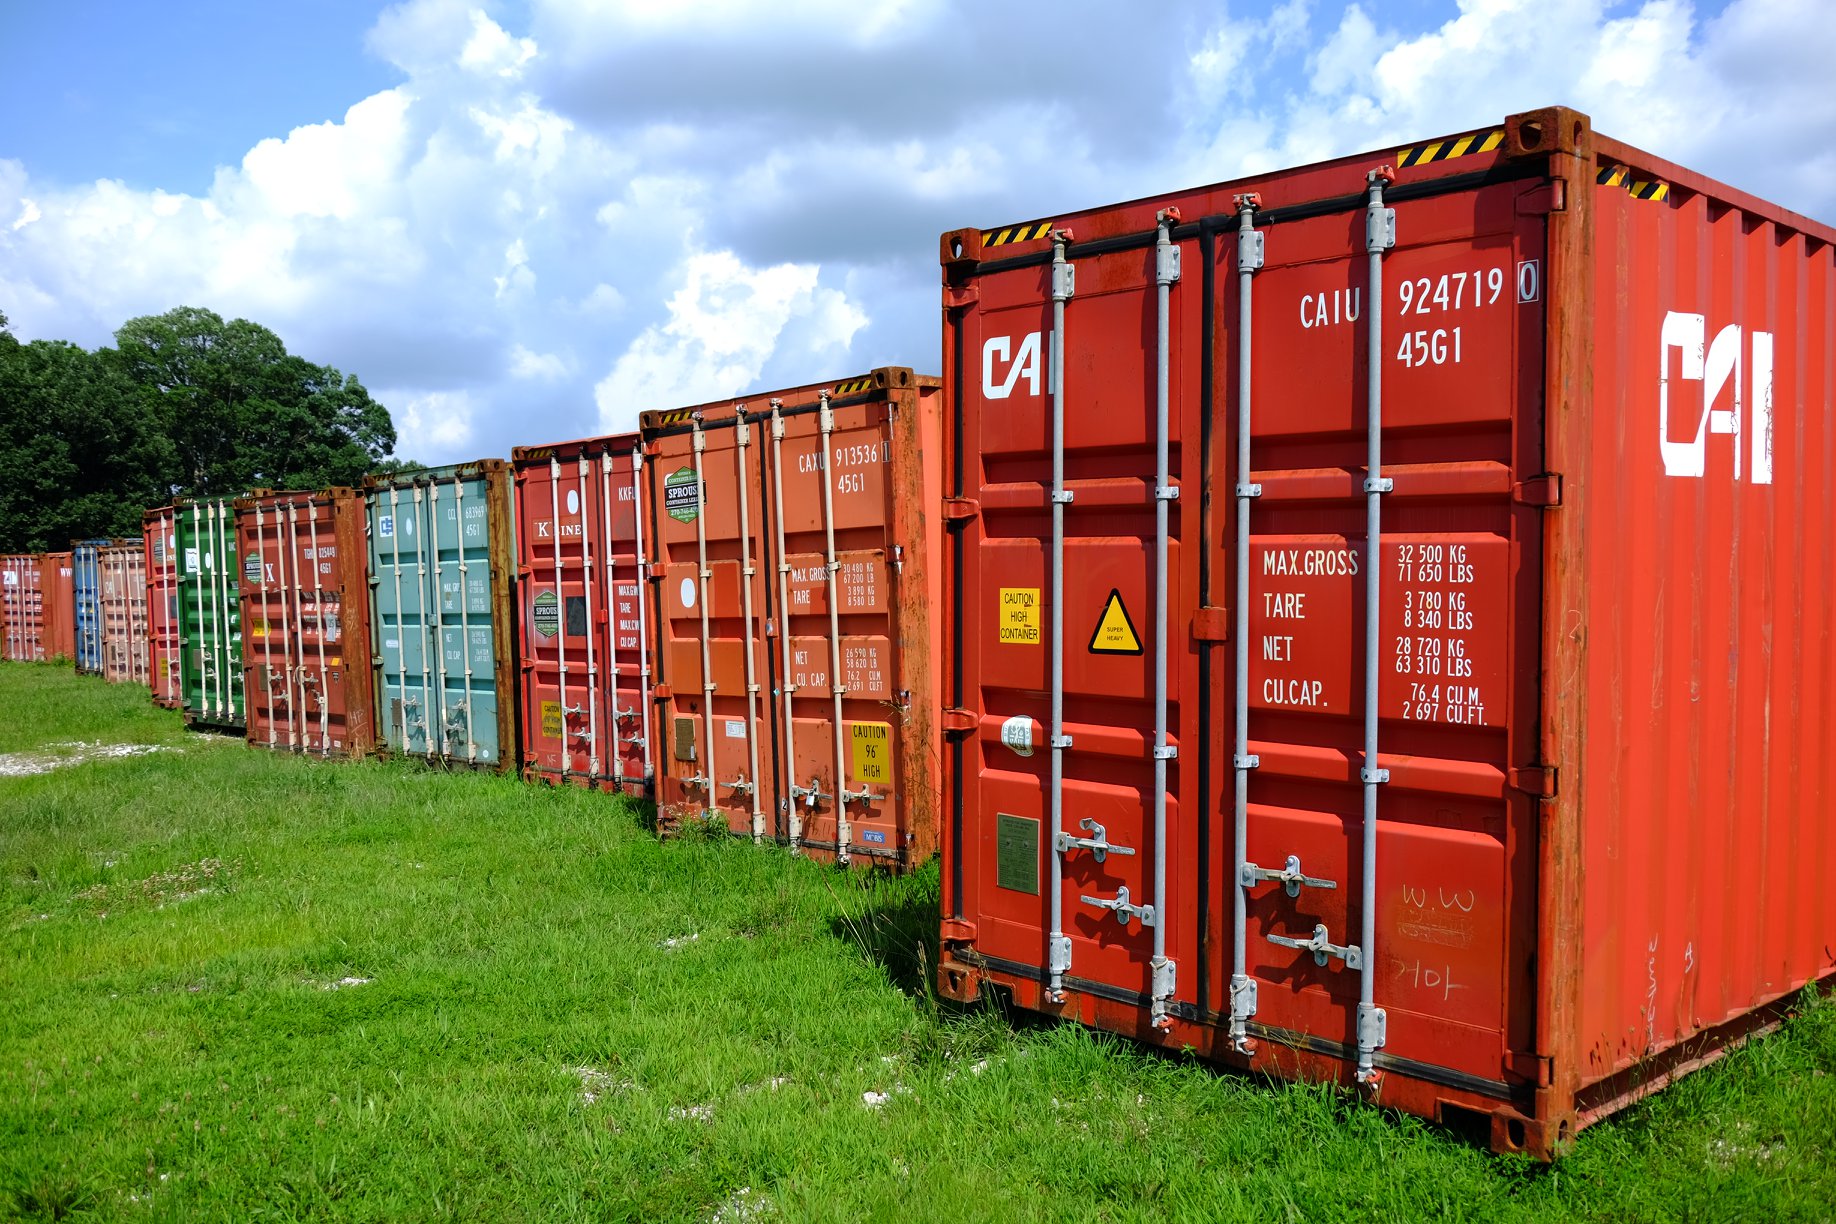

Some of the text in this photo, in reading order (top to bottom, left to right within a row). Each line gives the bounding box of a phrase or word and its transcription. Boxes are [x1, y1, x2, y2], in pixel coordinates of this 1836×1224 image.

[1300, 287, 1360, 328] CAIU
[1399, 267, 1503, 316] 924719
[1397, 327, 1461, 367] 45G1
[1660, 310, 1773, 485] CAI
[836, 444, 877, 467] 913536
[668, 485, 698, 499] SPROUS
[838, 473, 864, 494] 45G1
[866, 562, 874, 572] KG
[1263, 545, 1466, 576] MAX.GROSS 32 500 KG
[1398, 564, 1474, 583] 71 650 LBS
[793, 589, 810, 604] TARE
[867, 585, 875, 595] KG
[1004, 592, 1034, 604] CAUTION
[619, 602, 631, 614] TARE
[1263, 591, 1465, 619] TARE 3 780 KG
[1010, 611, 1027, 623] HIGH
[1404, 610, 1473, 630] 8 340 LBS
[1000, 627, 1038, 640] CONTAINER
[795, 651, 808, 665] NET
[1263, 635, 1464, 662] NET 28 720 KG
[1395, 656, 1472, 677] 63 310 LBS
[1411, 683, 1439, 702] 76.4
[1446, 685, 1483, 707] CU.M.
[1403, 702, 1488, 726] 2 697 CU.FT.
[853, 724, 886, 739] CAUTION
[863, 764, 881, 778] HIGH
